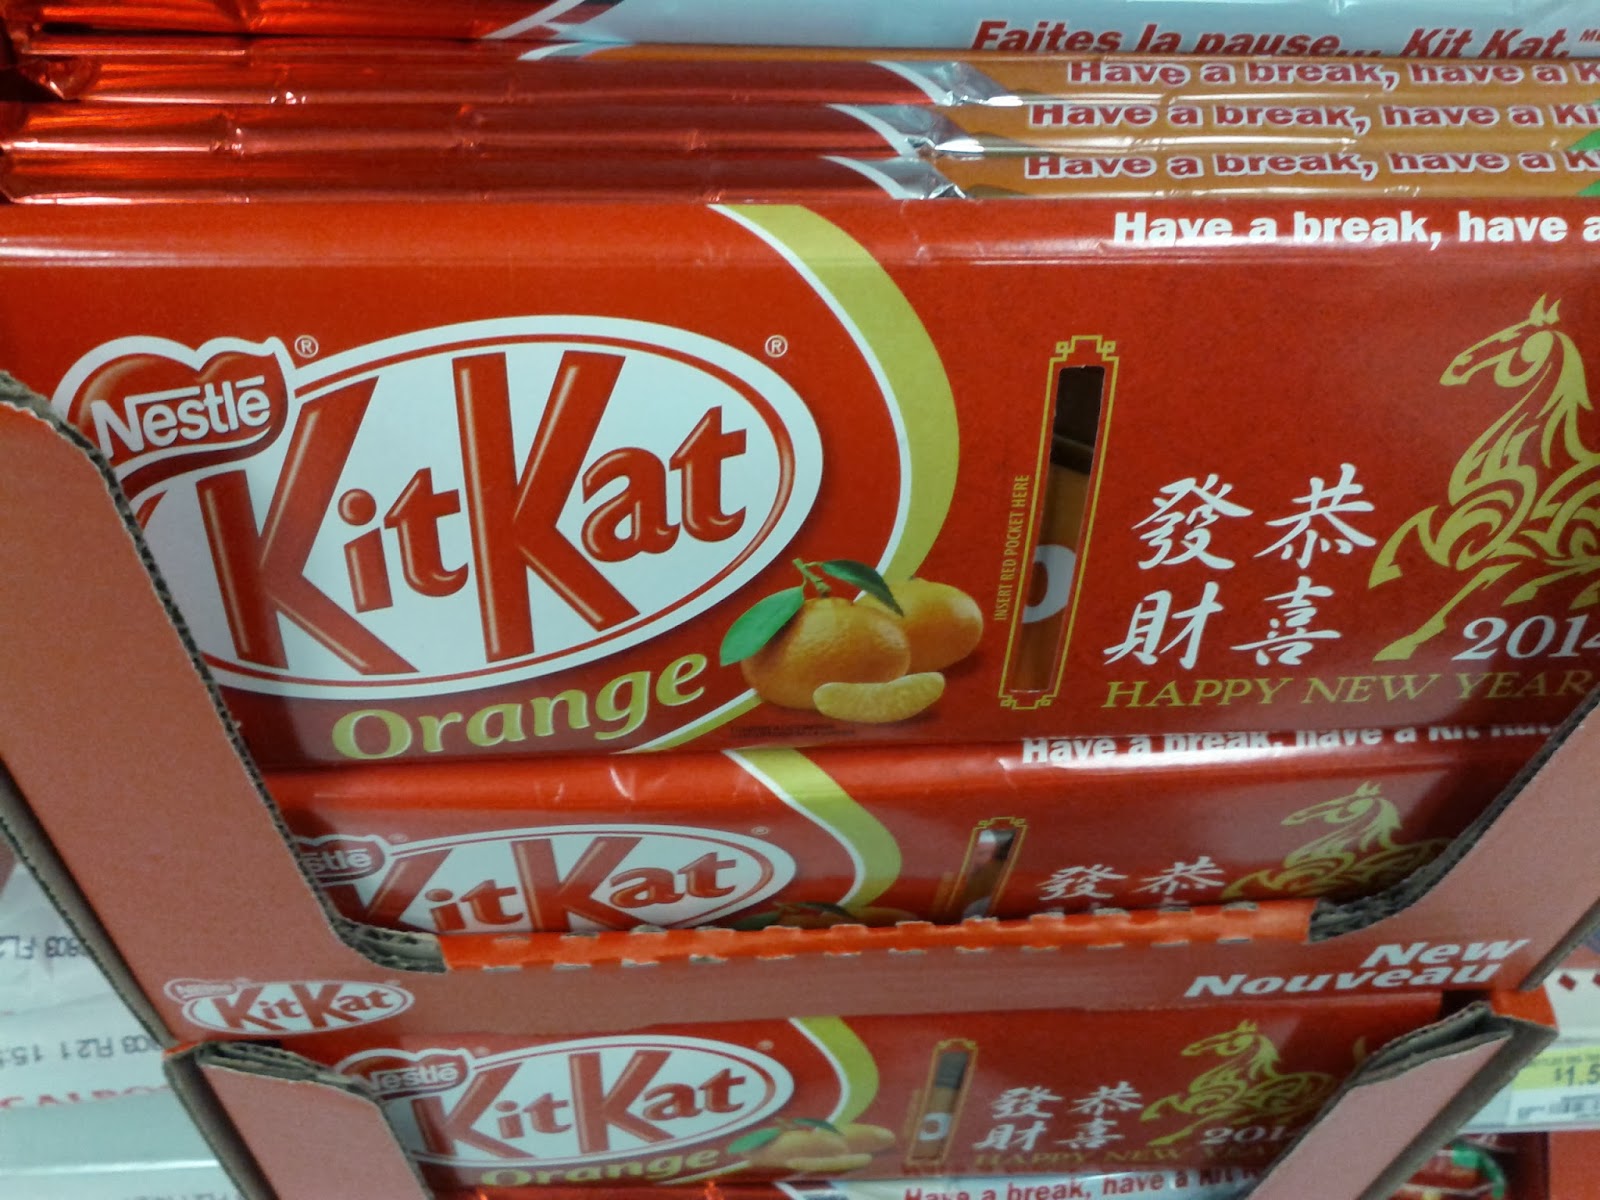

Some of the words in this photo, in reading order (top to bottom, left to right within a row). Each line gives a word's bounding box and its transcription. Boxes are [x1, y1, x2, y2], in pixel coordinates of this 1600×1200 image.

[971, 20, 1123, 51] Faites
[1134, 23, 1182, 52] la
[1400, 28, 1473, 57] Kit
[1067, 61, 1190, 86] Have
[1201, 63, 1236, 84] a
[1246, 61, 1398, 92] break,
[1409, 63, 1524, 84] have
[1533, 65, 1568, 84] a
[1030, 104, 1157, 127] Have
[1168, 104, 1203, 126] a
[1213, 103, 1371, 135] break,
[1380, 104, 1500, 127] have
[1508, 105, 1544, 127] a
[1025, 155, 1157, 179] Have
[1167, 156, 1204, 179] a
[1213, 152, 1378, 181] break,
[1386, 152, 1509, 174] have
[1518, 152, 1556, 172] a
[1113, 211, 1233, 248] Have
[1249, 217, 1277, 242] a
[1293, 210, 1442, 251] break,
[1457, 210, 1568, 243] have
[1011, 475, 1030, 508] HERE
[196, 350, 748, 676] KitKat
[1004, 512, 1025, 556] POCKET
[1000, 560, 1017, 581] RED
[994, 584, 1012, 621] INSERT
[331, 652, 707, 761] Orange
[1101, 678, 1290, 708] HAPPY
[1301, 673, 1441, 704] NEW
[1455, 670, 1594, 699] YEAR
[1022, 736, 1117, 765] Have
[1128, 734, 1152, 757] a
[1394, 726, 1417, 744] a
[1361, 939, 1531, 968] New
[1184, 963, 1500, 998] Nouveau
[208, 983, 399, 1032] KitKat
[413, 1050, 747, 1160] KitKat
[480, 1149, 719, 1188] Orange
[981, 1189, 997, 1200] a
[1007, 1179, 1092, 1200] break,
[1102, 1173, 1164, 1196] have
[1174, 1171, 1189, 1188] a
